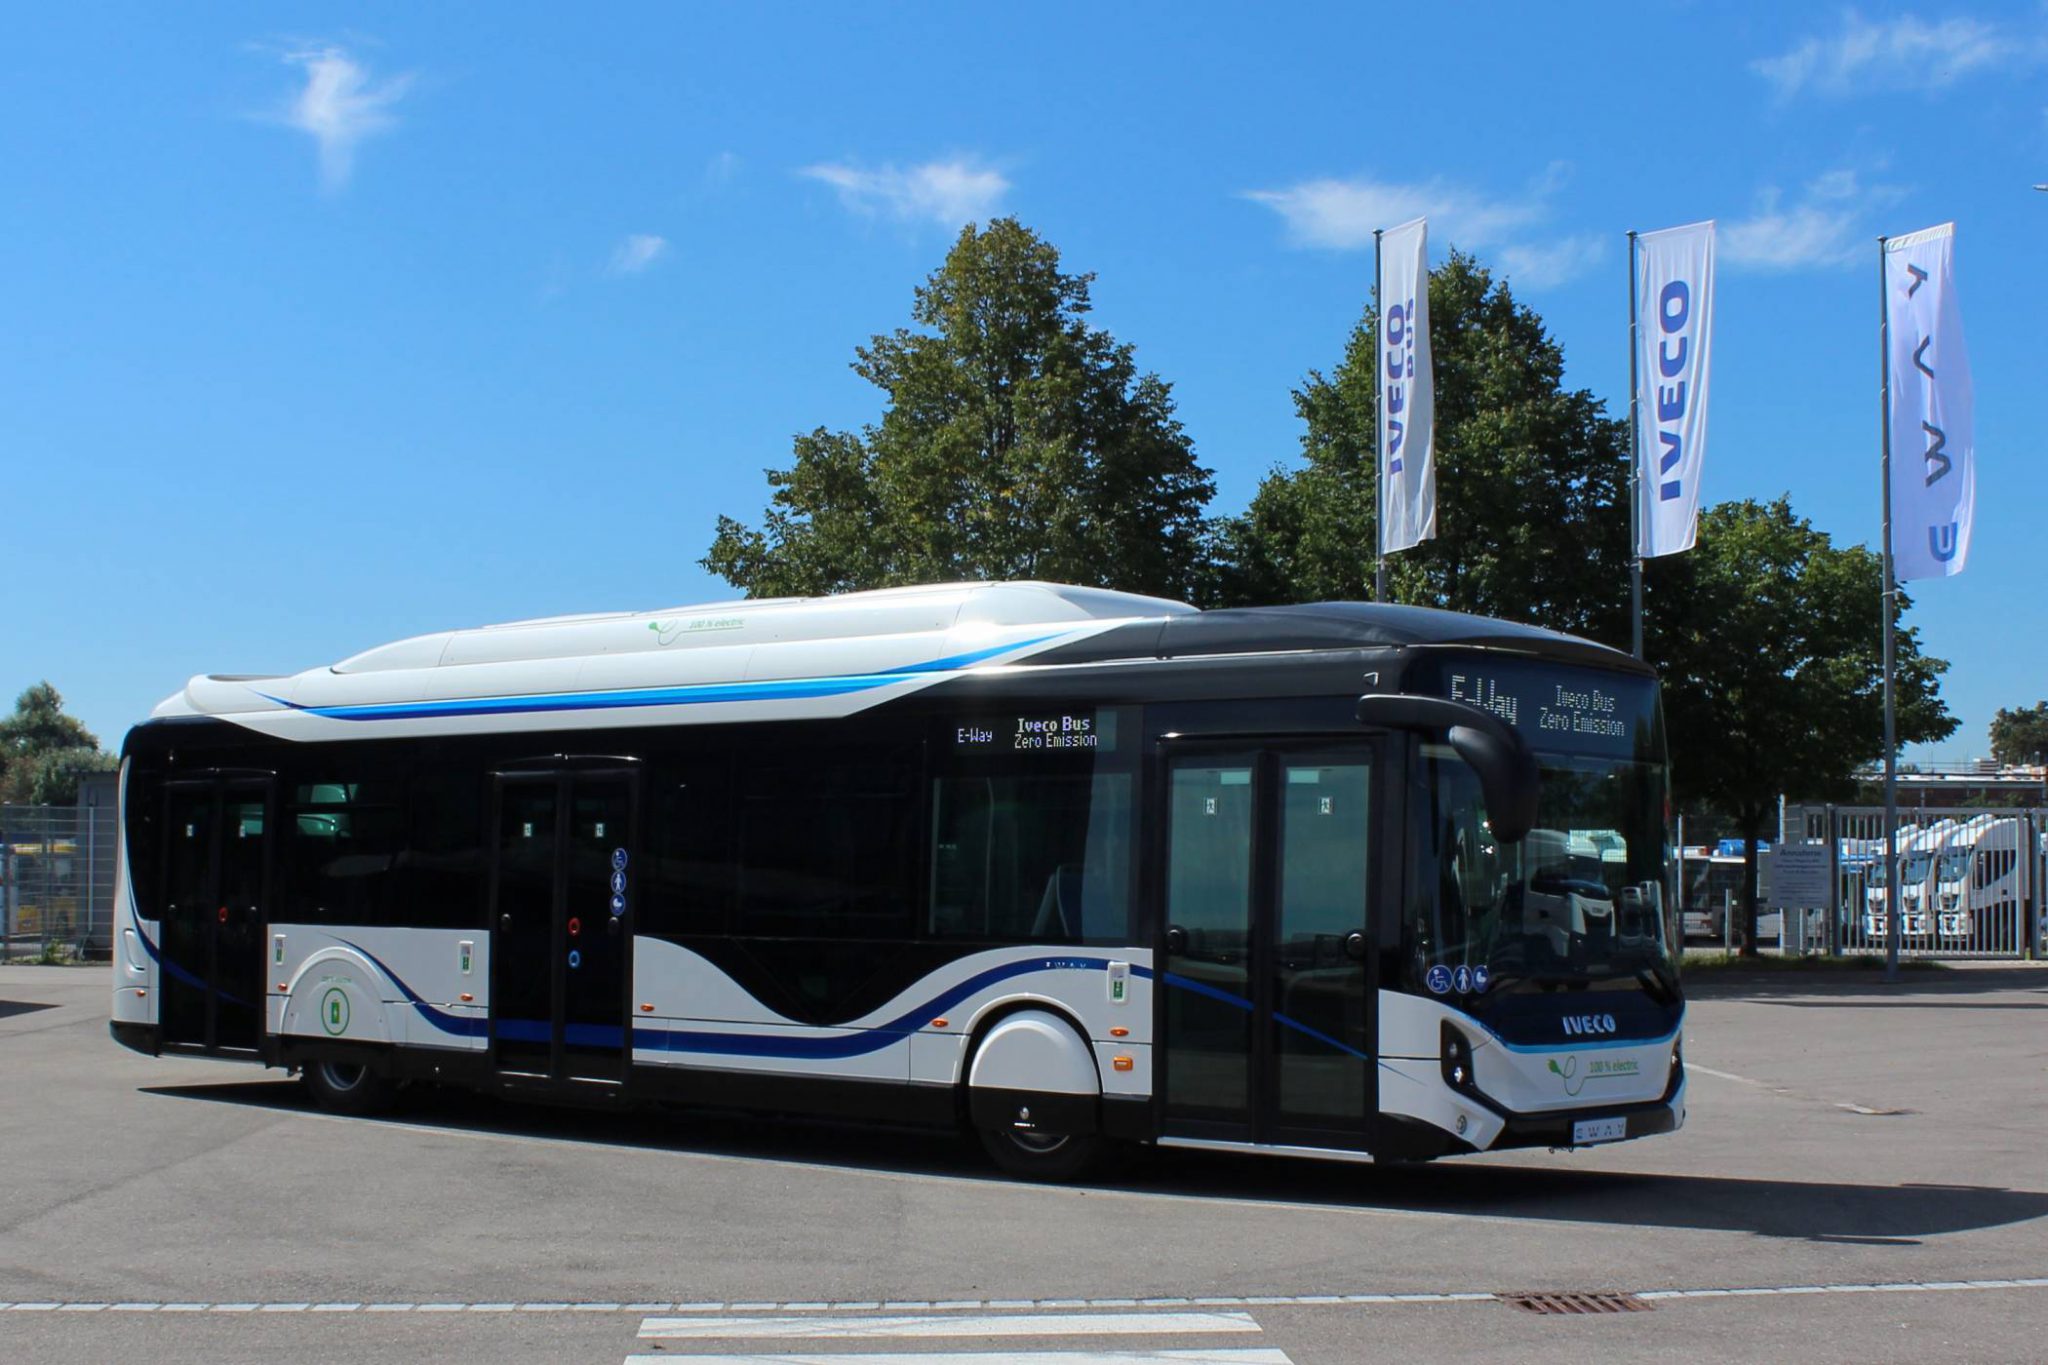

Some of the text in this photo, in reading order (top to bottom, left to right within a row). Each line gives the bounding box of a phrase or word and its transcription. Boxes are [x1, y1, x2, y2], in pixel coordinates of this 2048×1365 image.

[1387, 303, 1405, 476] IVECO
[1658, 280, 1690, 502] IVECO
[1556, 685, 1615, 713] Iveco Bus
[1017, 716, 1091, 733] Iveco Bus
[1540, 706, 1625, 737] Zero Emission
[957, 727, 993, 743] E-Way
[1014, 731, 1098, 749] Zero Emission
[1562, 1014, 1617, 1035] IVECO
